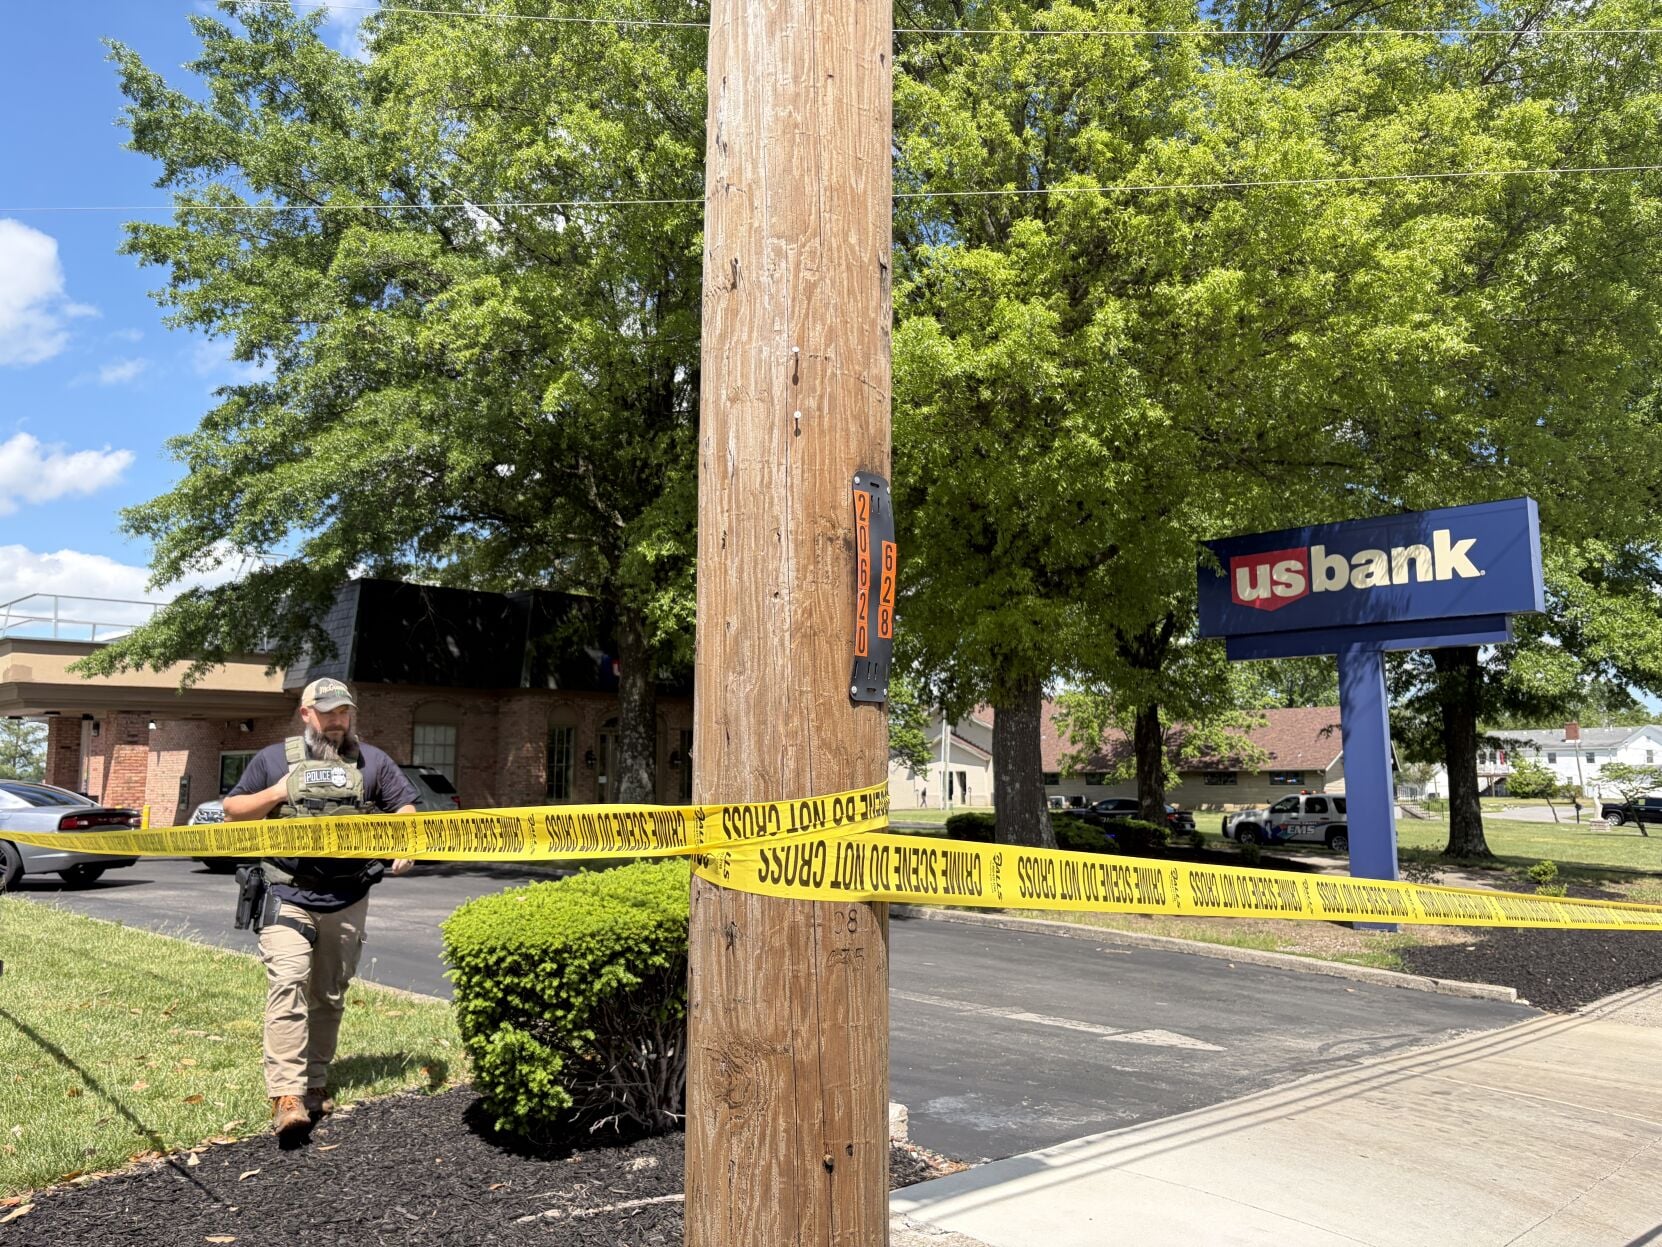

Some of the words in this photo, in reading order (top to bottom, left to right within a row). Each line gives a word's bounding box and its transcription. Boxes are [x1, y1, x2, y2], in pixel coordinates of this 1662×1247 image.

[858, 493, 867, 654] 20620
[882, 544, 893, 635] 628
[306, 770, 331, 782] POLICE
[648, 810, 687, 850] CRIME
[723, 804, 780, 841] CROSS
[787, 800, 826, 834] NOT
[833, 796, 856, 826] DO
[1287, 825, 1315, 834] EMS
[423, 819, 446, 852] CROSS
[471, 818, 498, 852] SCENE
[497, 817, 525, 852] CRIME
[545, 814, 578, 852] CROSS
[577, 813, 599, 852] NOT
[597, 813, 615, 851] DO
[613, 811, 651, 851] SCENE
[758, 840, 826, 888] CROSS
[830, 842, 866, 890] NOT
[870, 844, 891, 891] DO
[894, 846, 938, 894] SCENE
[941, 850, 983, 896] CRIME
[1017, 856, 1056, 899] CROSS
[1060, 860, 1081, 900] NOT
[1083, 861, 1099, 901] DO
[1099, 864, 1134, 904] SCENE
[1133, 867, 1166, 906] CRIME
[1189, 870, 1221, 907] CROSS
[1220, 873, 1239, 908] NOT
[1237, 875, 1252, 909] DO
[1249, 876, 1278, 910] SCENE
[1274, 879, 1302, 912] CRIME
